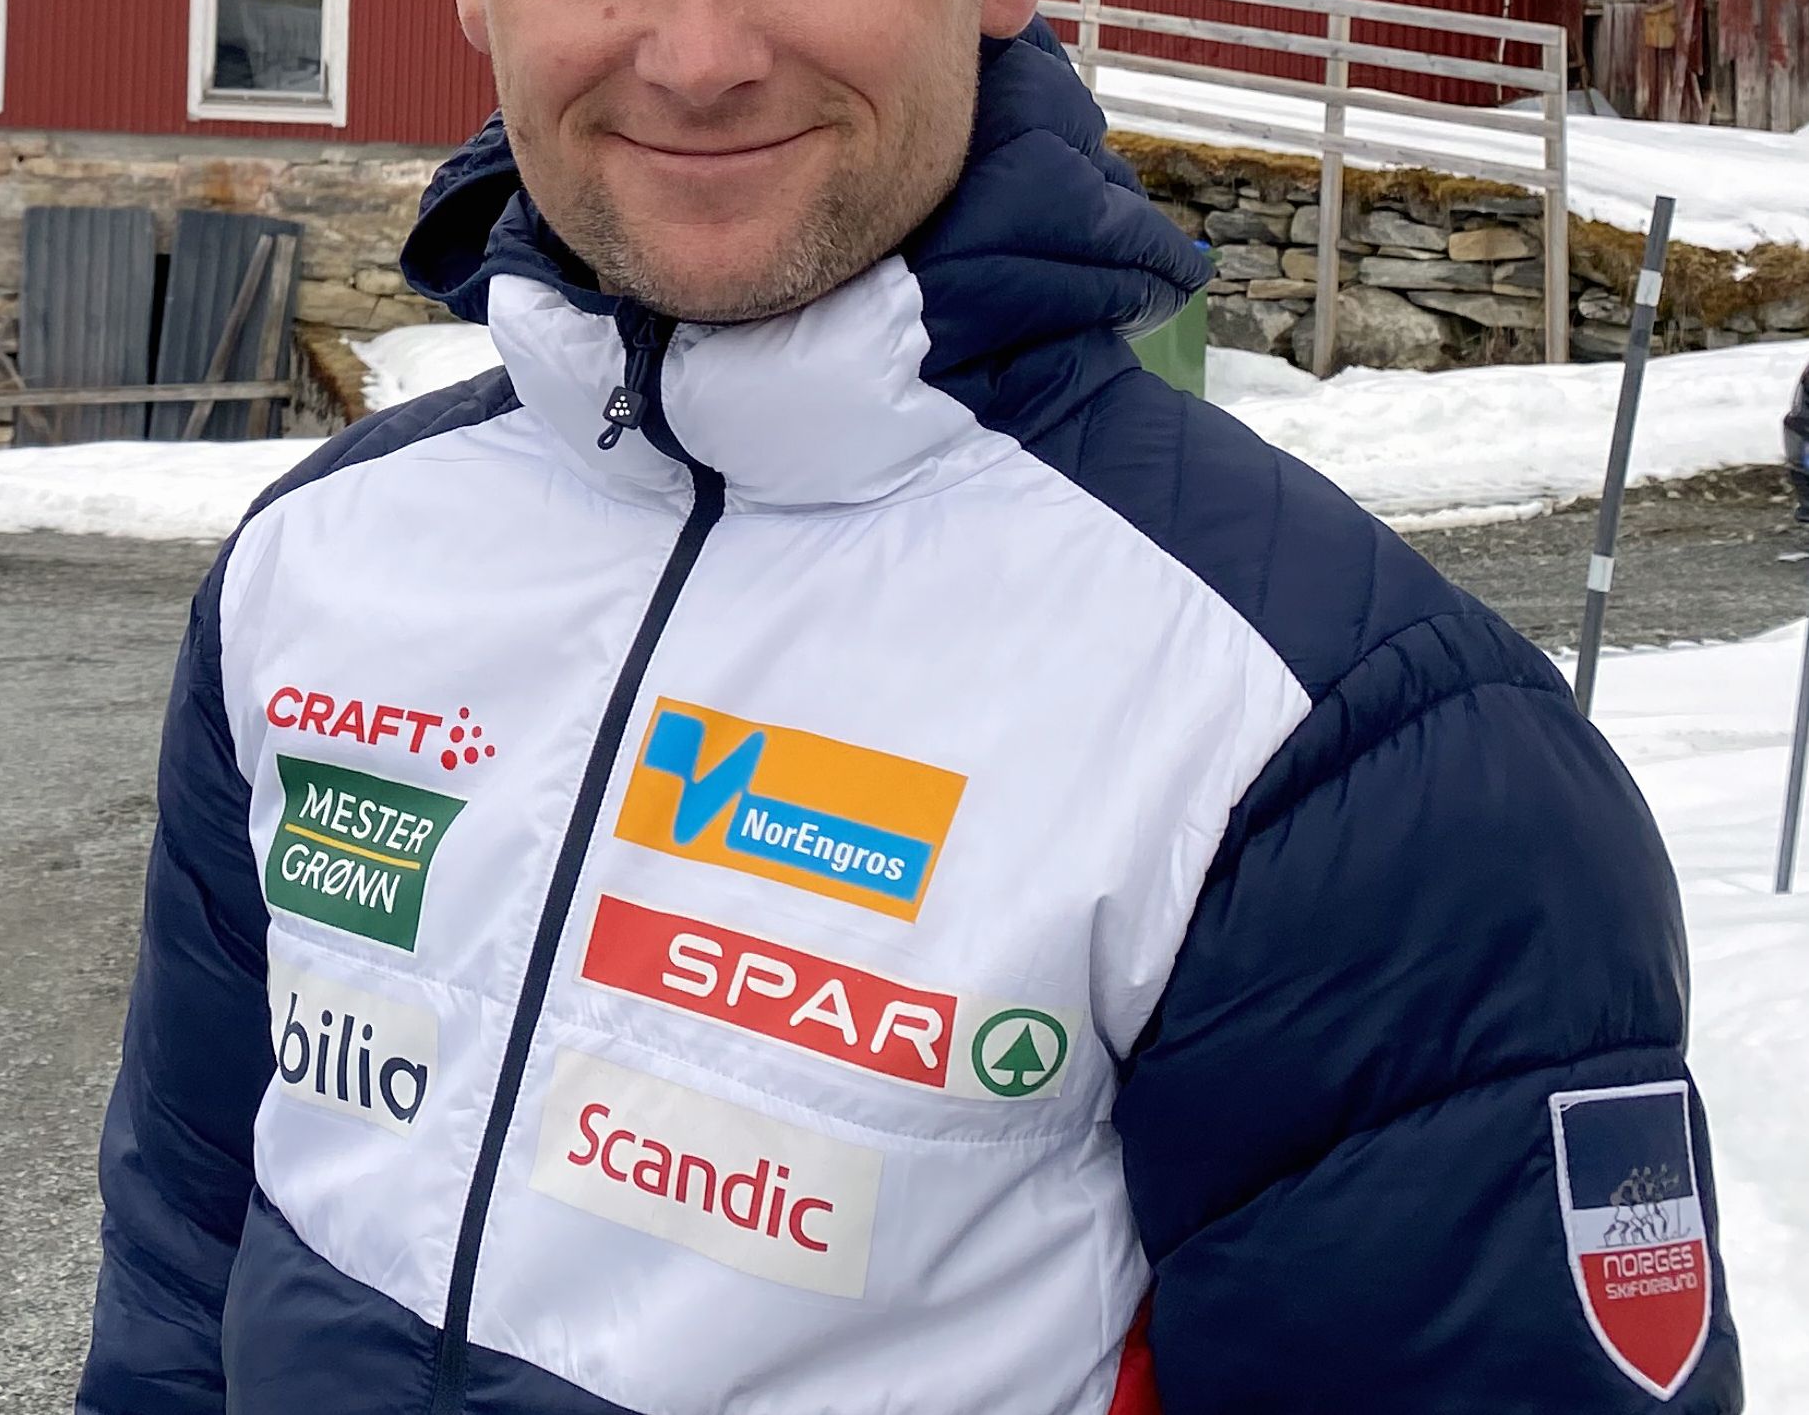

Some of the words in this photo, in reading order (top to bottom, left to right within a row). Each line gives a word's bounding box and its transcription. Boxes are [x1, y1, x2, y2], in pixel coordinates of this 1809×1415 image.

[266, 686, 443, 754] CRAFT
[298, 782, 434, 854] MESTER
[740, 808, 906, 881] NorEngros
[281, 843, 401, 914] GRØNN
[661, 932, 944, 1070] SPAR
[278, 991, 428, 1124] bilia
[567, 1103, 834, 1252] Scandic
[1603, 1245, 1695, 1280] NORGES
[1605, 1272, 1698, 1300] SKIFORBUND
